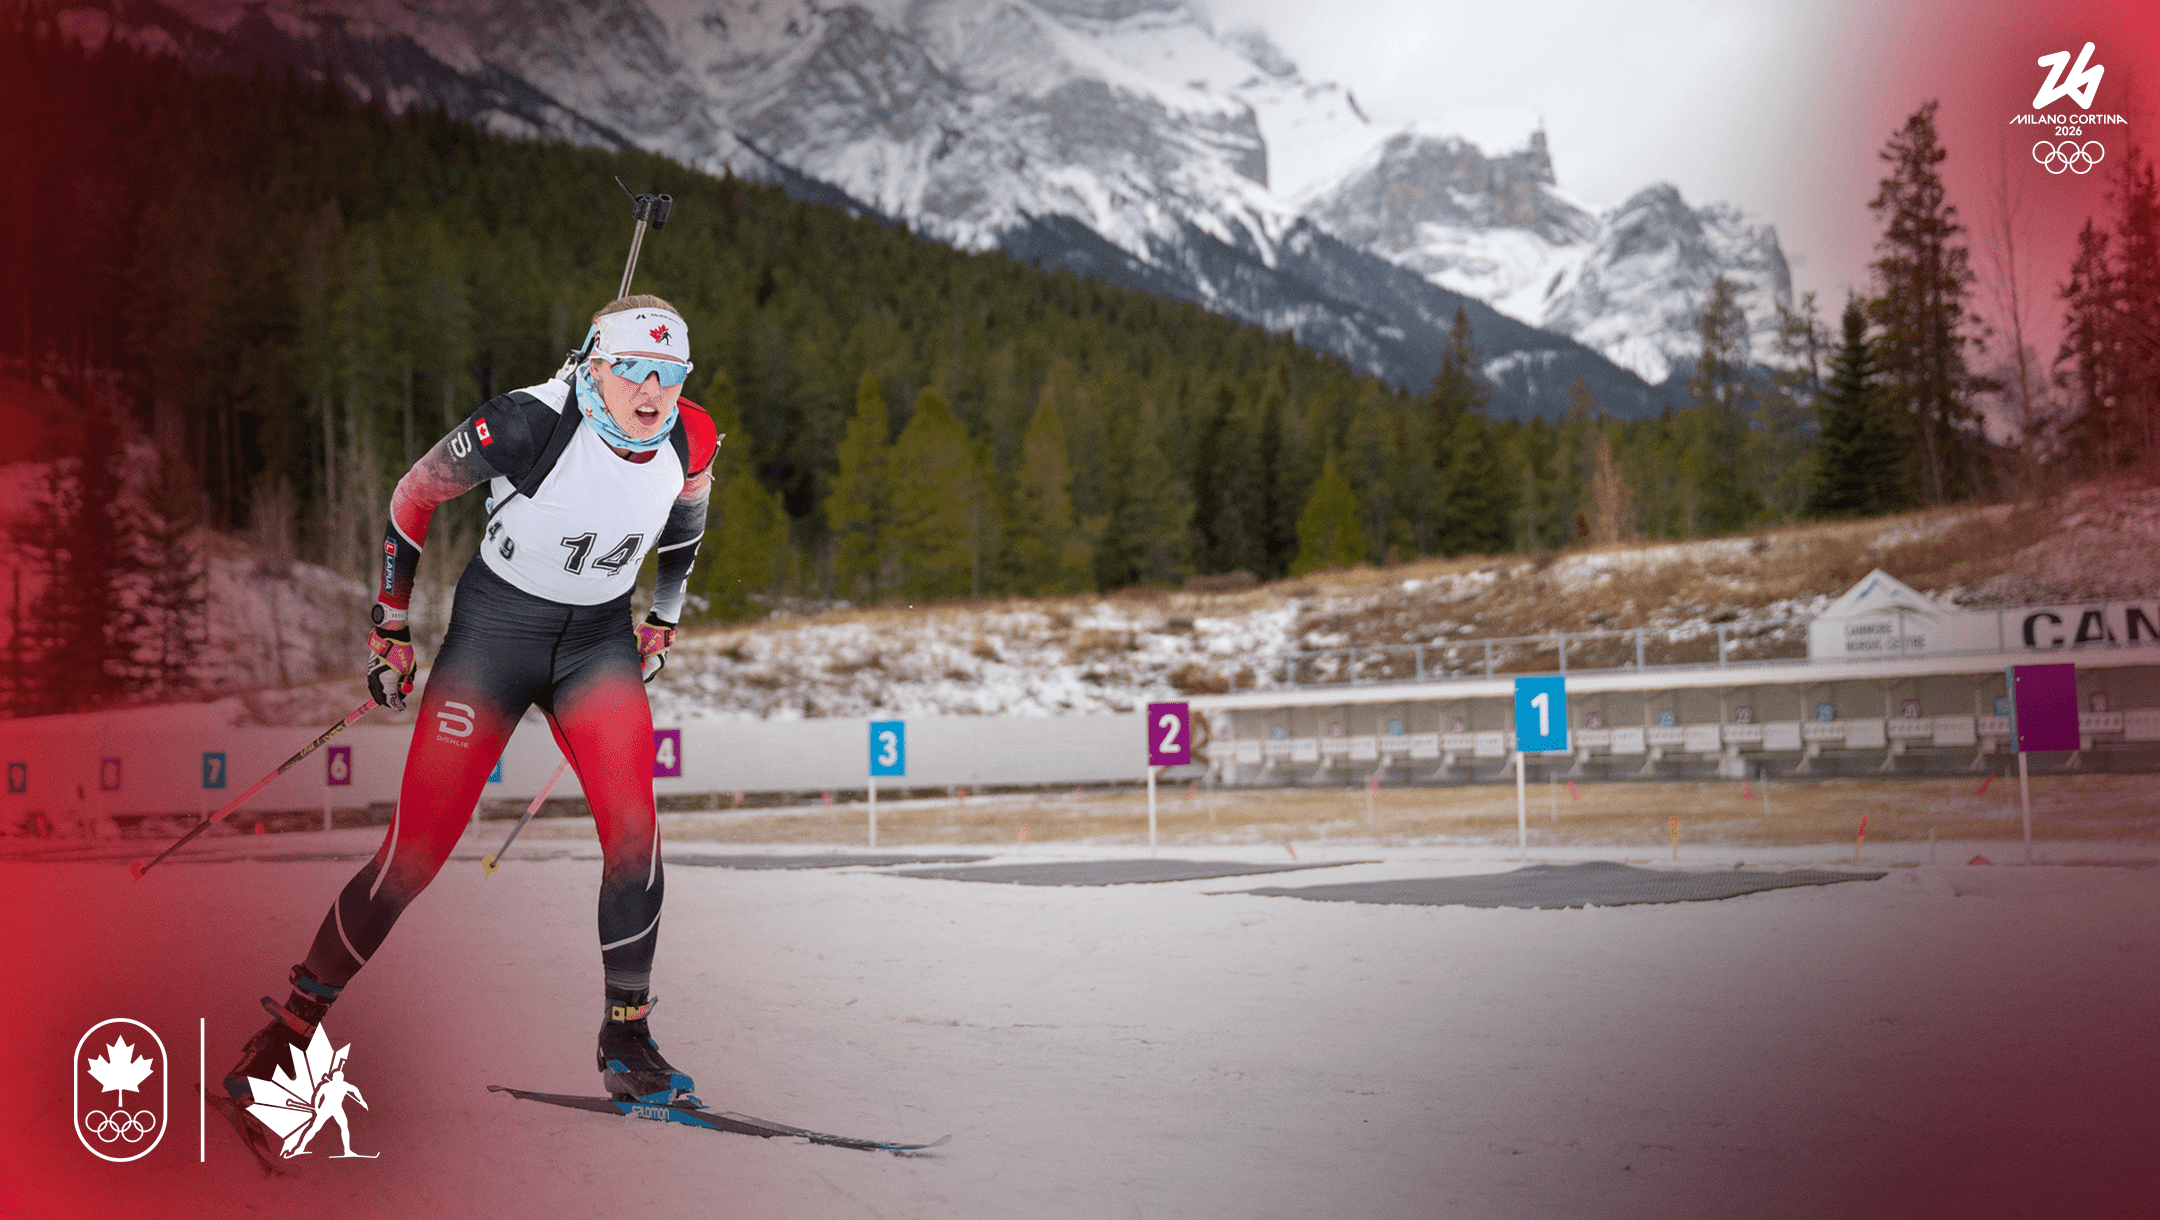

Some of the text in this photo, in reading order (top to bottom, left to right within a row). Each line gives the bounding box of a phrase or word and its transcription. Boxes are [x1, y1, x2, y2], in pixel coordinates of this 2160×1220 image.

[560, 531, 645, 577] 14
[385, 555, 393, 590] LAPUA
[1530, 692, 1550, 737] 1
[878, 730, 898, 767] 3
[1158, 713, 1182, 754] 2
[207, 758, 222, 784] 7
[330, 751, 348, 781] 6
[656, 737, 676, 769] 4
